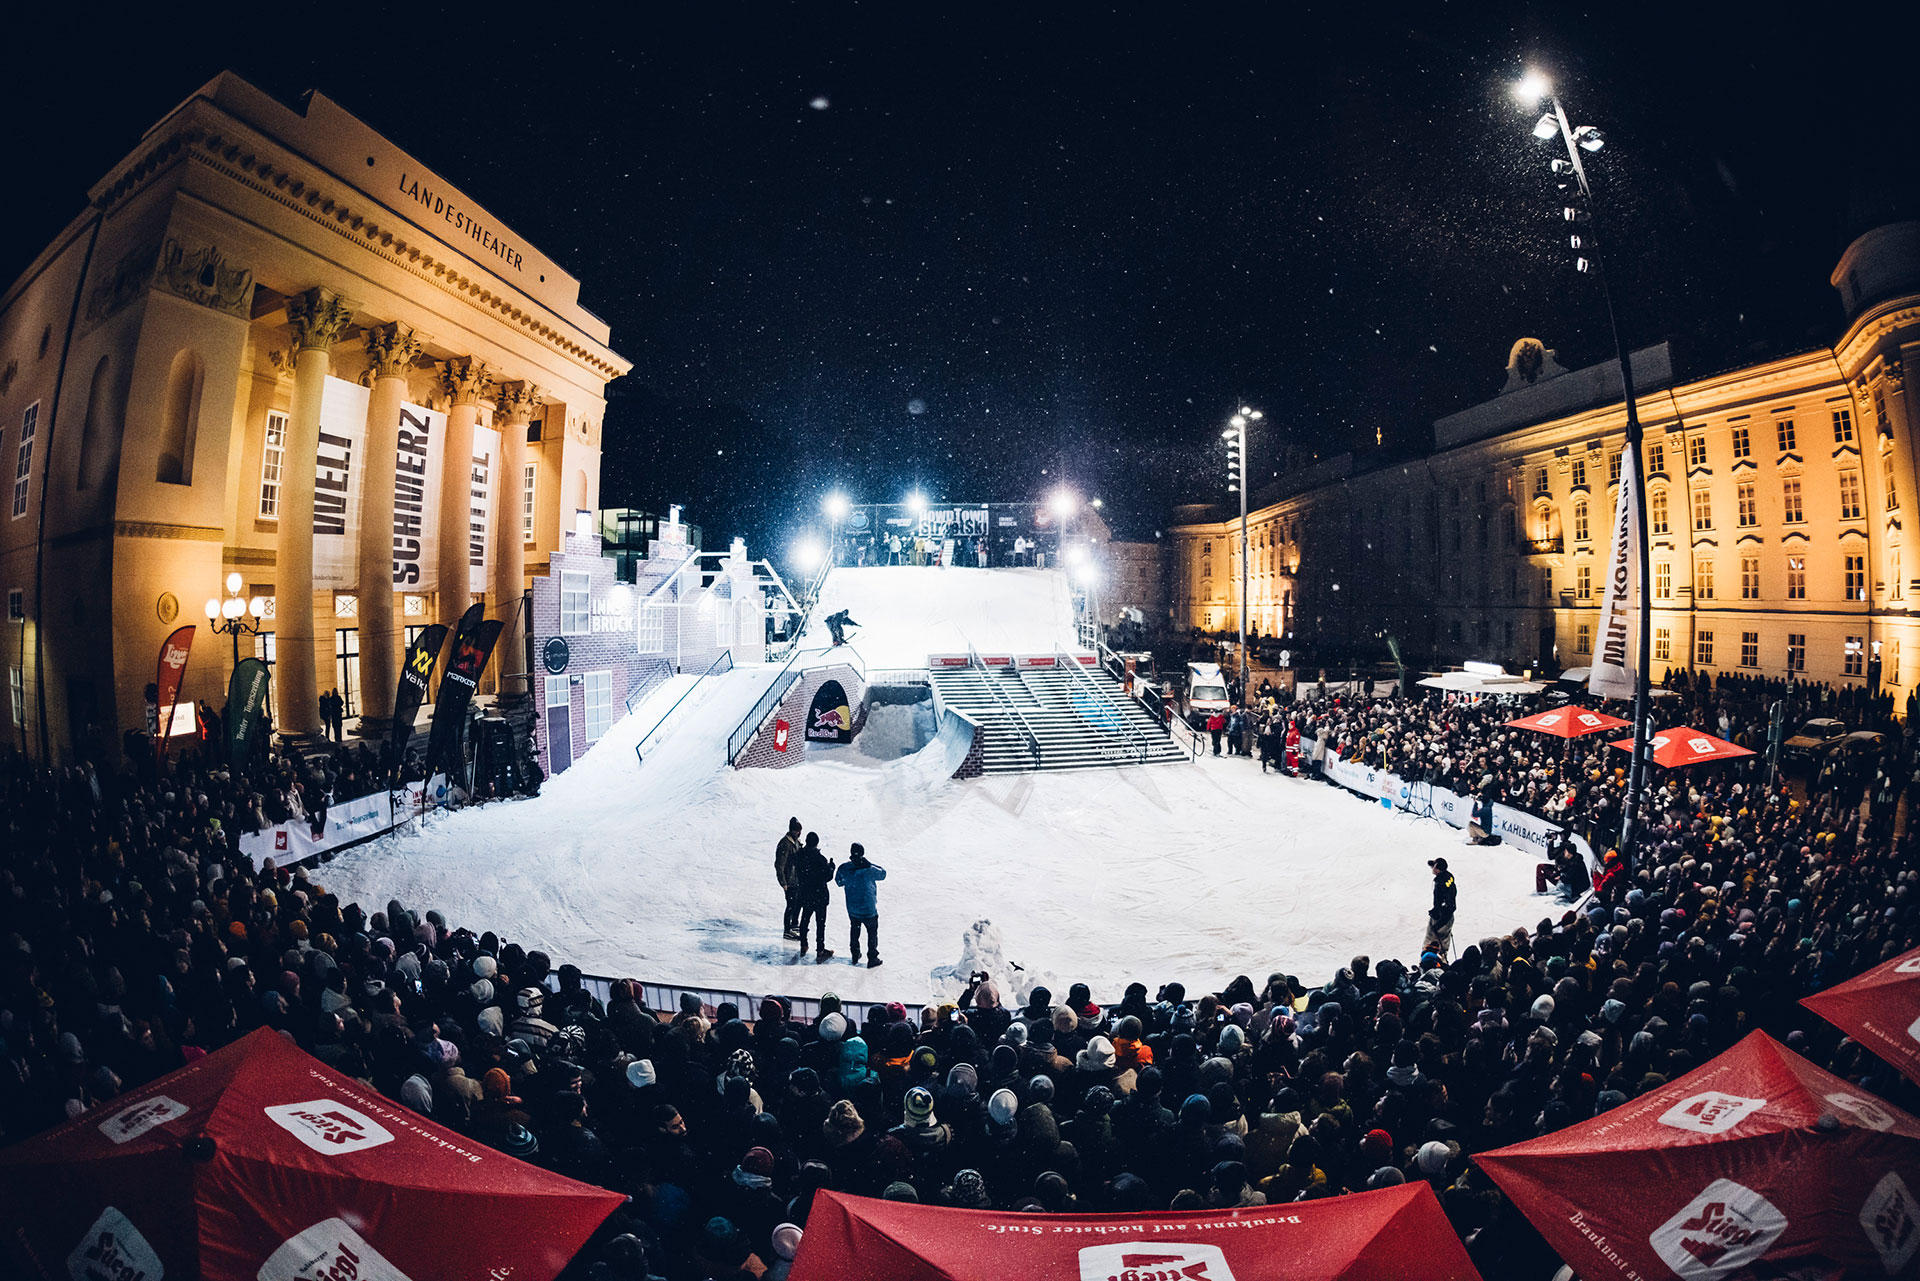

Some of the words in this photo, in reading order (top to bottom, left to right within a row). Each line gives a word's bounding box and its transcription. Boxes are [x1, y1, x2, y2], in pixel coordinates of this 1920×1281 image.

[399, 172, 523, 272] LANDESTHEATER
[313, 425, 352, 535] WELT
[393, 408, 431, 585] SCHMERZ
[592, 615, 634, 632] BRUCK
[338, 1087, 384, 1114] höchster
[288, 1110, 368, 1145] Stiegl
[382, 1112, 410, 1127] auf
[410, 1126, 483, 1163] Braukunst
[980, 1223, 1043, 1235] Stufe.
[1052, 1224, 1145, 1235] höchster
[1152, 1224, 1186, 1233] auf
[1195, 1215, 1303, 1232] Braukunst
[1680, 1202, 1764, 1246] Stiegl
[1569, 1211, 1629, 1271] Braukunst
[1107, 1261, 1209, 1281] Stieg
